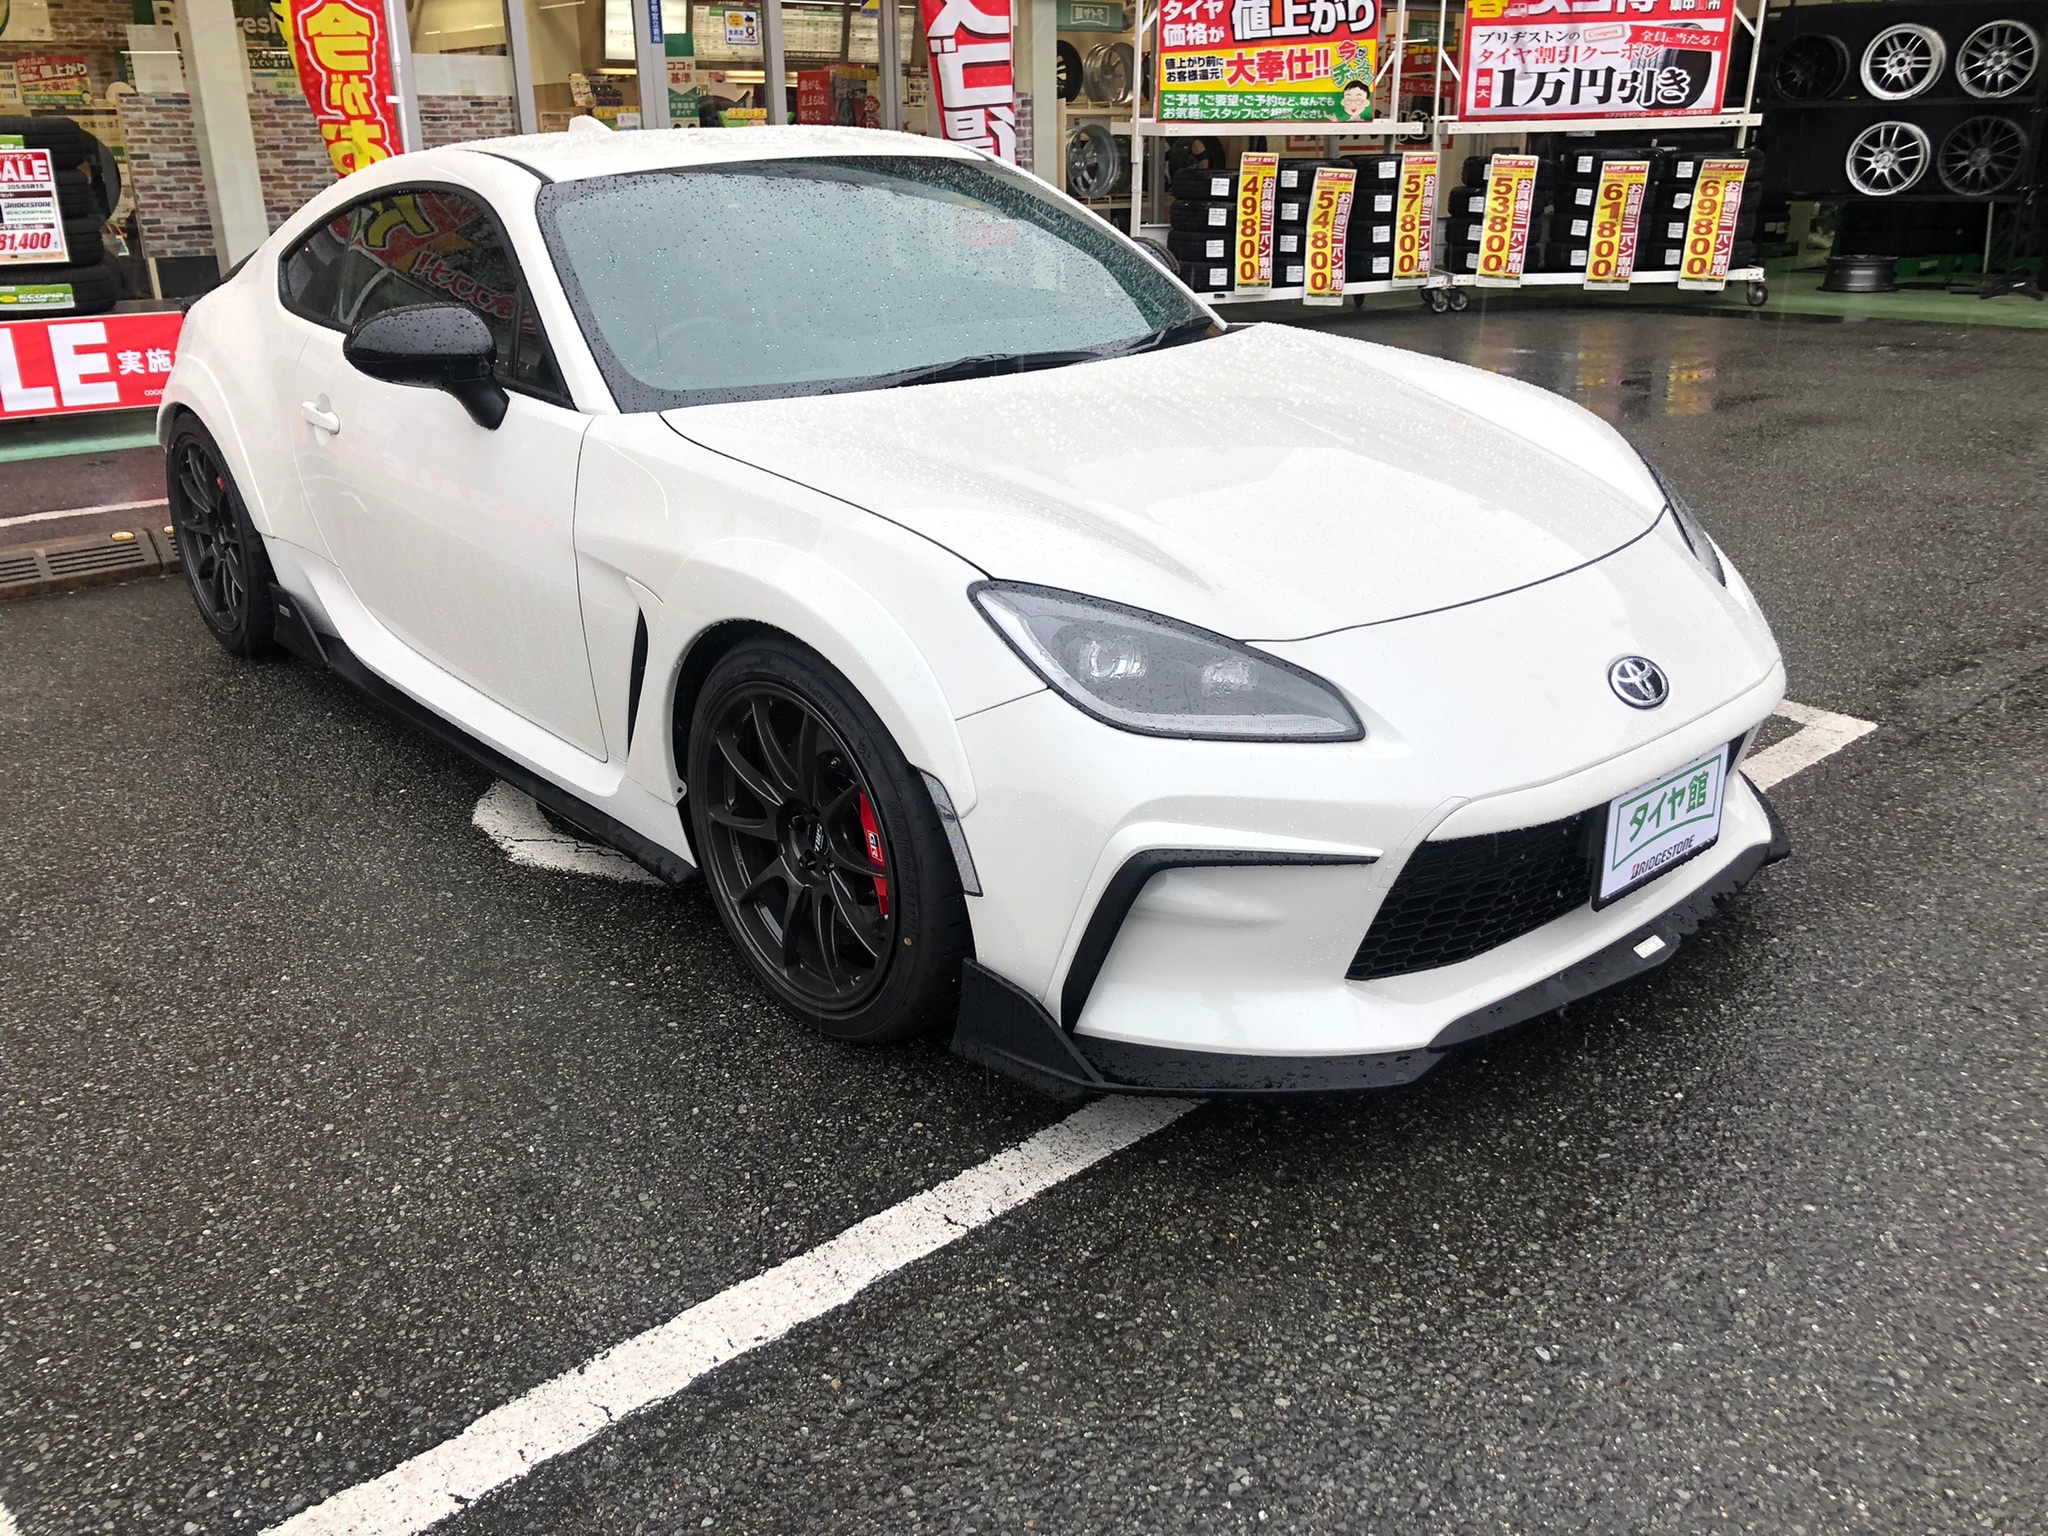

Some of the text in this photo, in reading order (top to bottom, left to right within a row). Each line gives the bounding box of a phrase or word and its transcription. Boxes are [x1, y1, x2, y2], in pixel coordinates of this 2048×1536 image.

[651, 0, 662, 43] 察官立寄所
[1162, 0, 1223, 21] タイヤ
[1232, 0, 1374, 40] 値上がり
[1163, 24, 1224, 47] 価格が
[1478, 30, 1580, 45] ブリヂストンの
[1165, 56, 1223, 70] 値上がり前に
[1478, 43, 1664, 65] タイヤ割引クーポン
[1477, 76, 1491, 99] 最大
[1494, 64, 1691, 107] 1万円引き
[117, 347, 177, 375] 実施
[1629, 770, 1709, 842] タイヤ館
[1630, 834, 1695, 880] BRIDGESTONE
